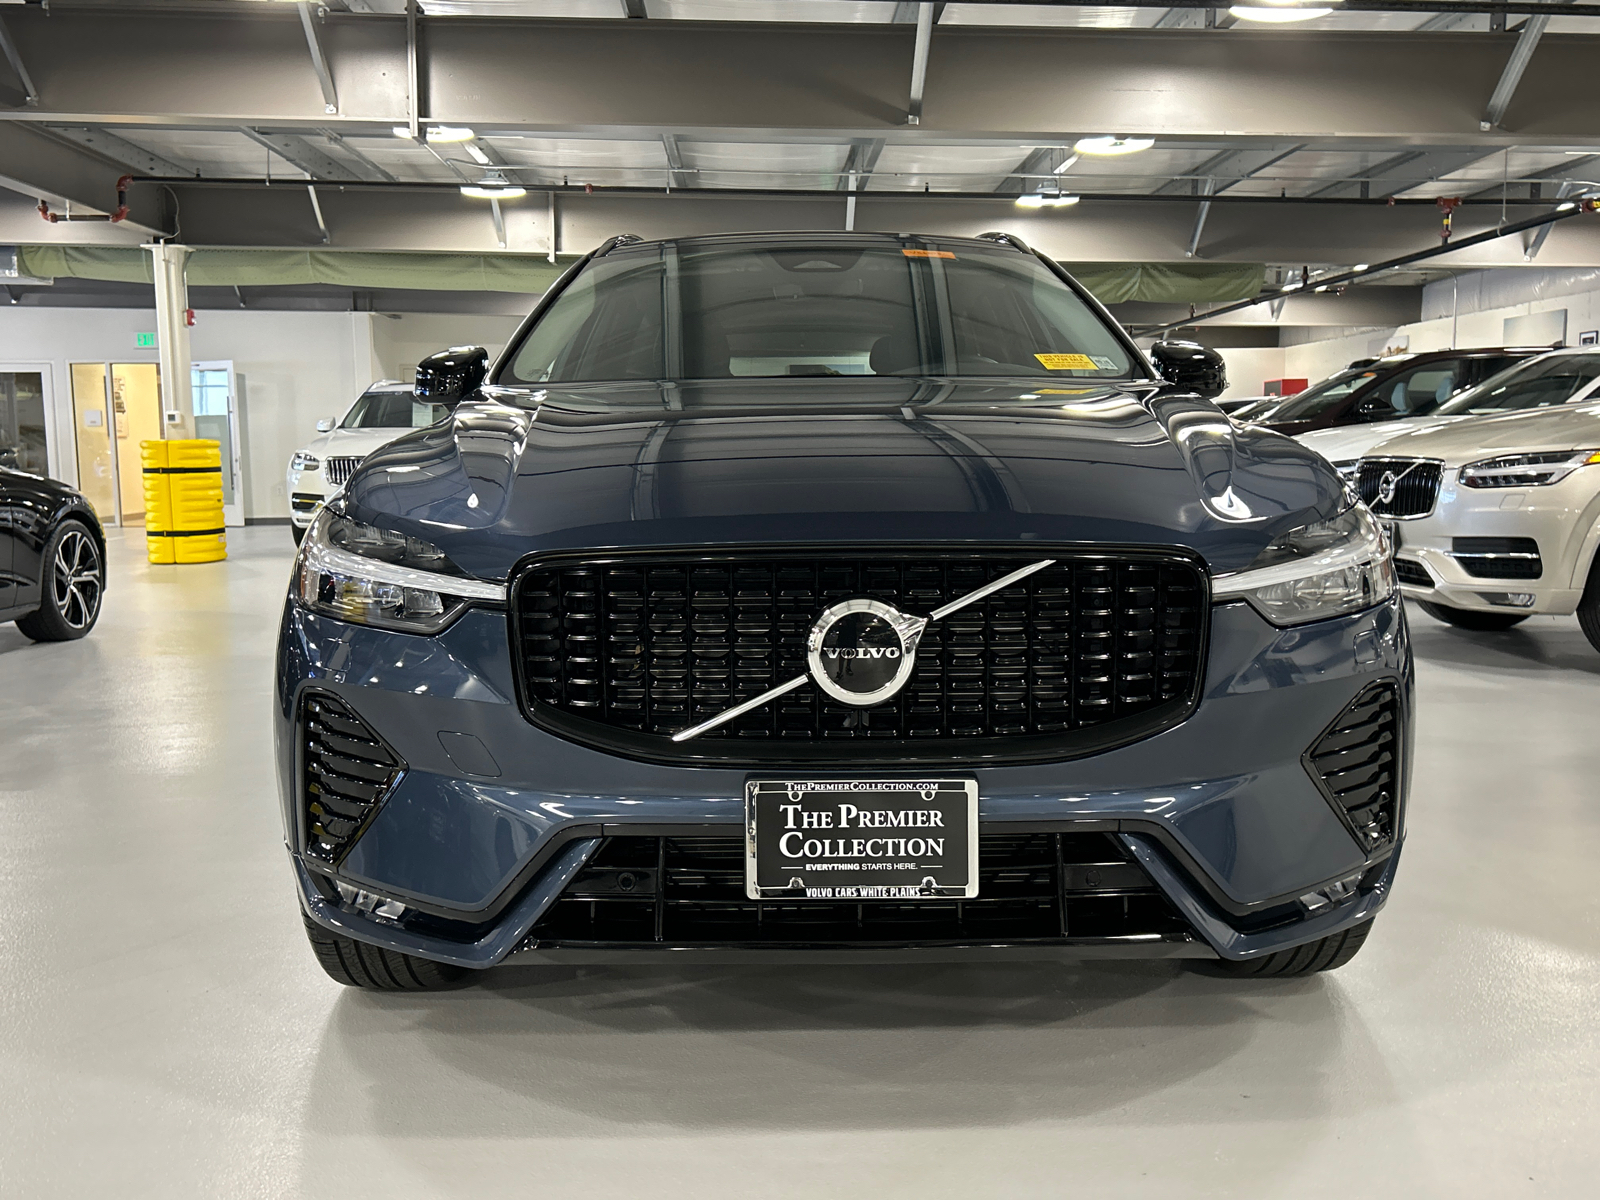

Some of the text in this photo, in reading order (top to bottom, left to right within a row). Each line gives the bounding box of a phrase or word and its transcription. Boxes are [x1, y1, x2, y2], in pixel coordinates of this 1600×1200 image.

[137, 332, 154, 346] EXIT
[823, 647, 900, 659] VOLVO
[784, 781, 939, 791] THEPREMIERCOLLECTION.COM
[779, 803, 945, 829] THE PREMIER
[779, 831, 945, 858] COLLECTION
[805, 862, 918, 871] EVERYTHING STARTS HERE.
[805, 886, 921, 898] VOLVO CARS WHITE PLAINS
